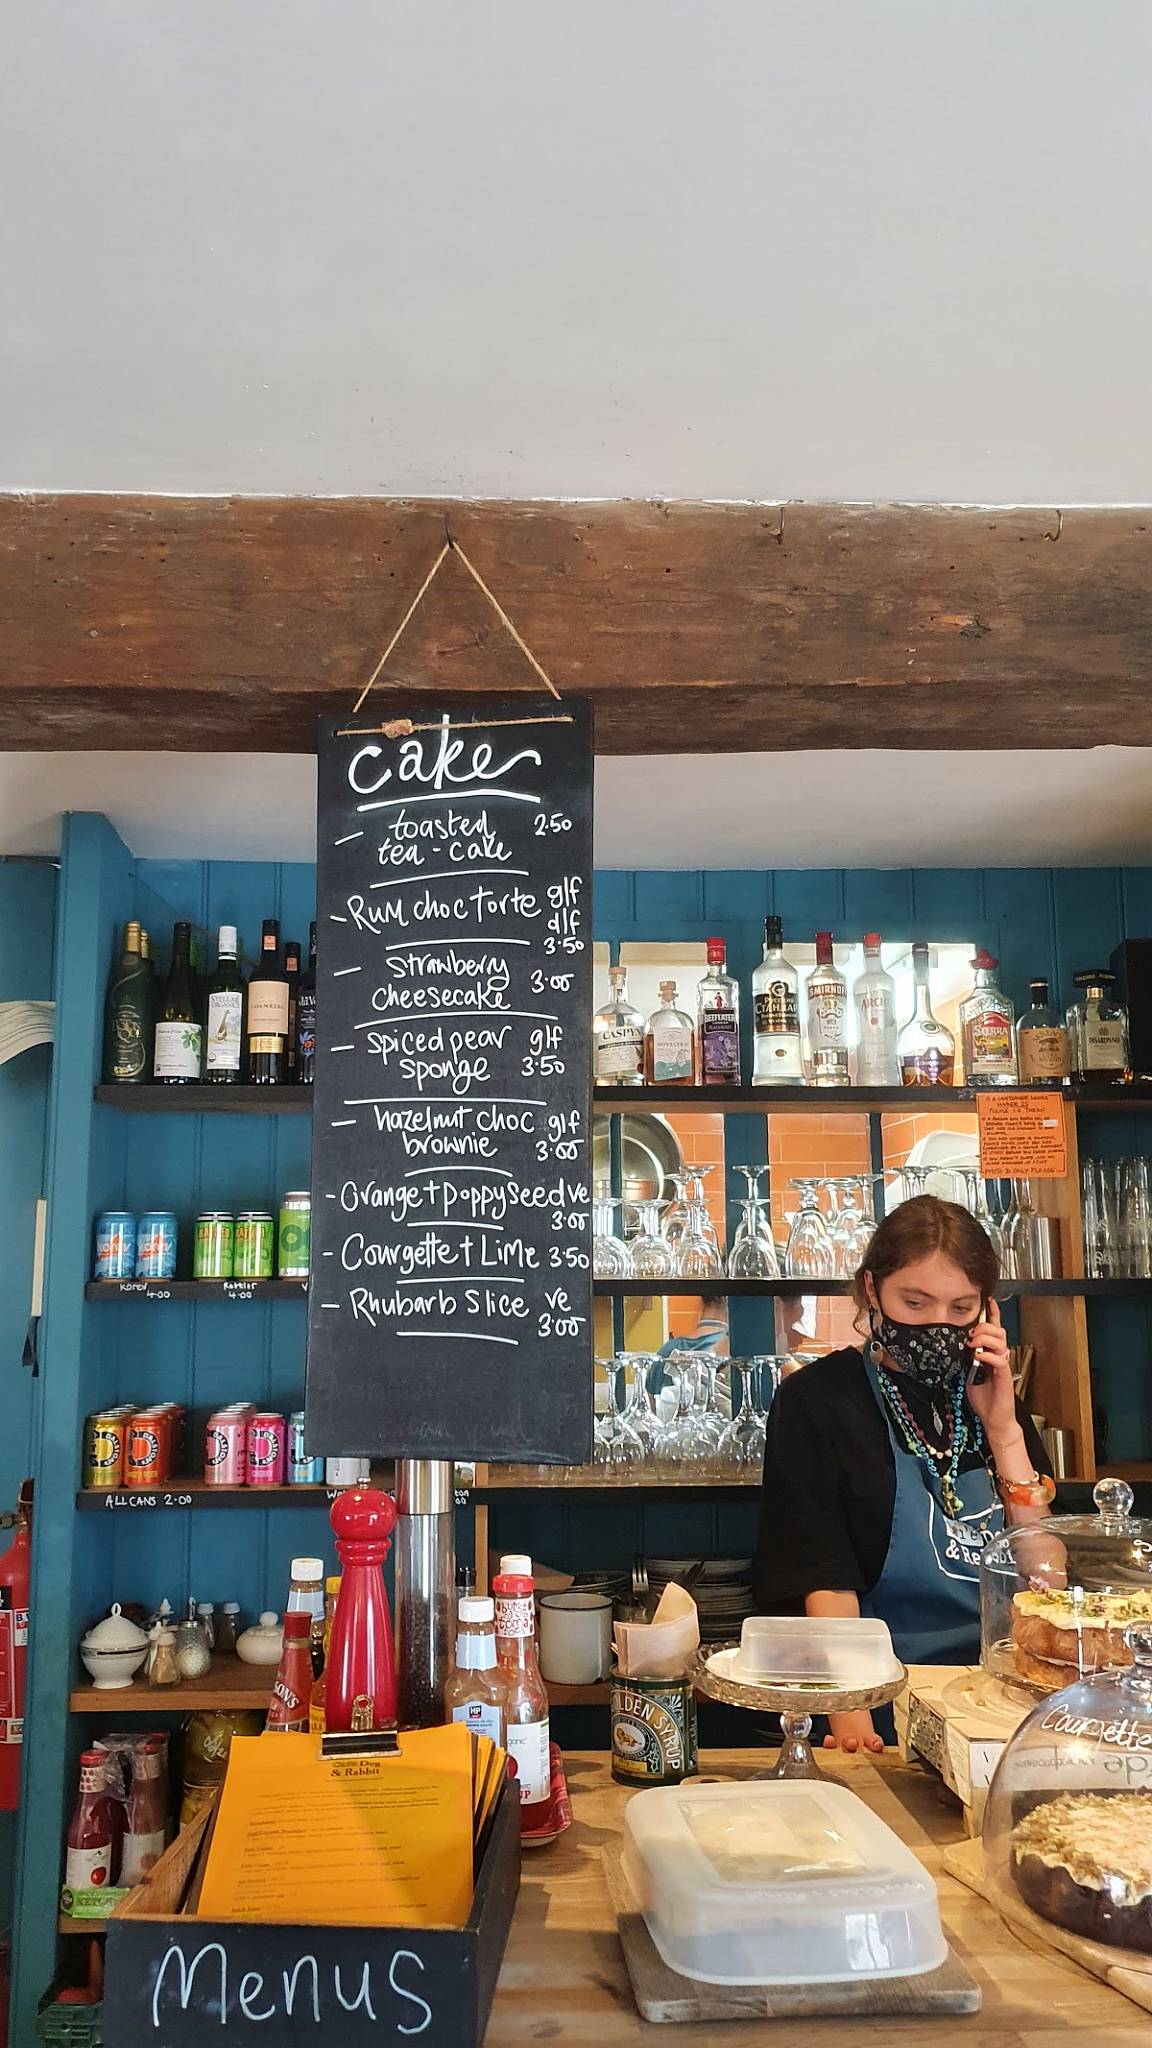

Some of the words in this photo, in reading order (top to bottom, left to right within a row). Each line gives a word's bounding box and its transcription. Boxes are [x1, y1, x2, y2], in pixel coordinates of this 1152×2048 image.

[347, 713, 541, 794] cake
[389, 809, 496, 841] toasted
[413, 890, 468, 919] choc
[470, 886, 541, 922] Torte
[372, 983, 512, 1011] cheesecake
[705, 1013, 736, 1022] BEEFEATER
[974, 1026, 1008, 1035] SIERRA
[449, 1024, 512, 1062] pear
[1089, 1036, 1121, 1044] DISARONNO
[400, 1055, 491, 1095] sponge
[374, 1105, 473, 1133] hazelnut
[476, 1105, 535, 1133] choc
[403, 1132, 498, 1158] brownie
[341, 1232, 459, 1274] Courgette
[350, 1287, 457, 1327] Rhubarb
[653, 1714, 681, 1770] SYRUP
[344, 1767, 380, 1776] Rabbit
[152, 1941, 433, 2035] Menus
